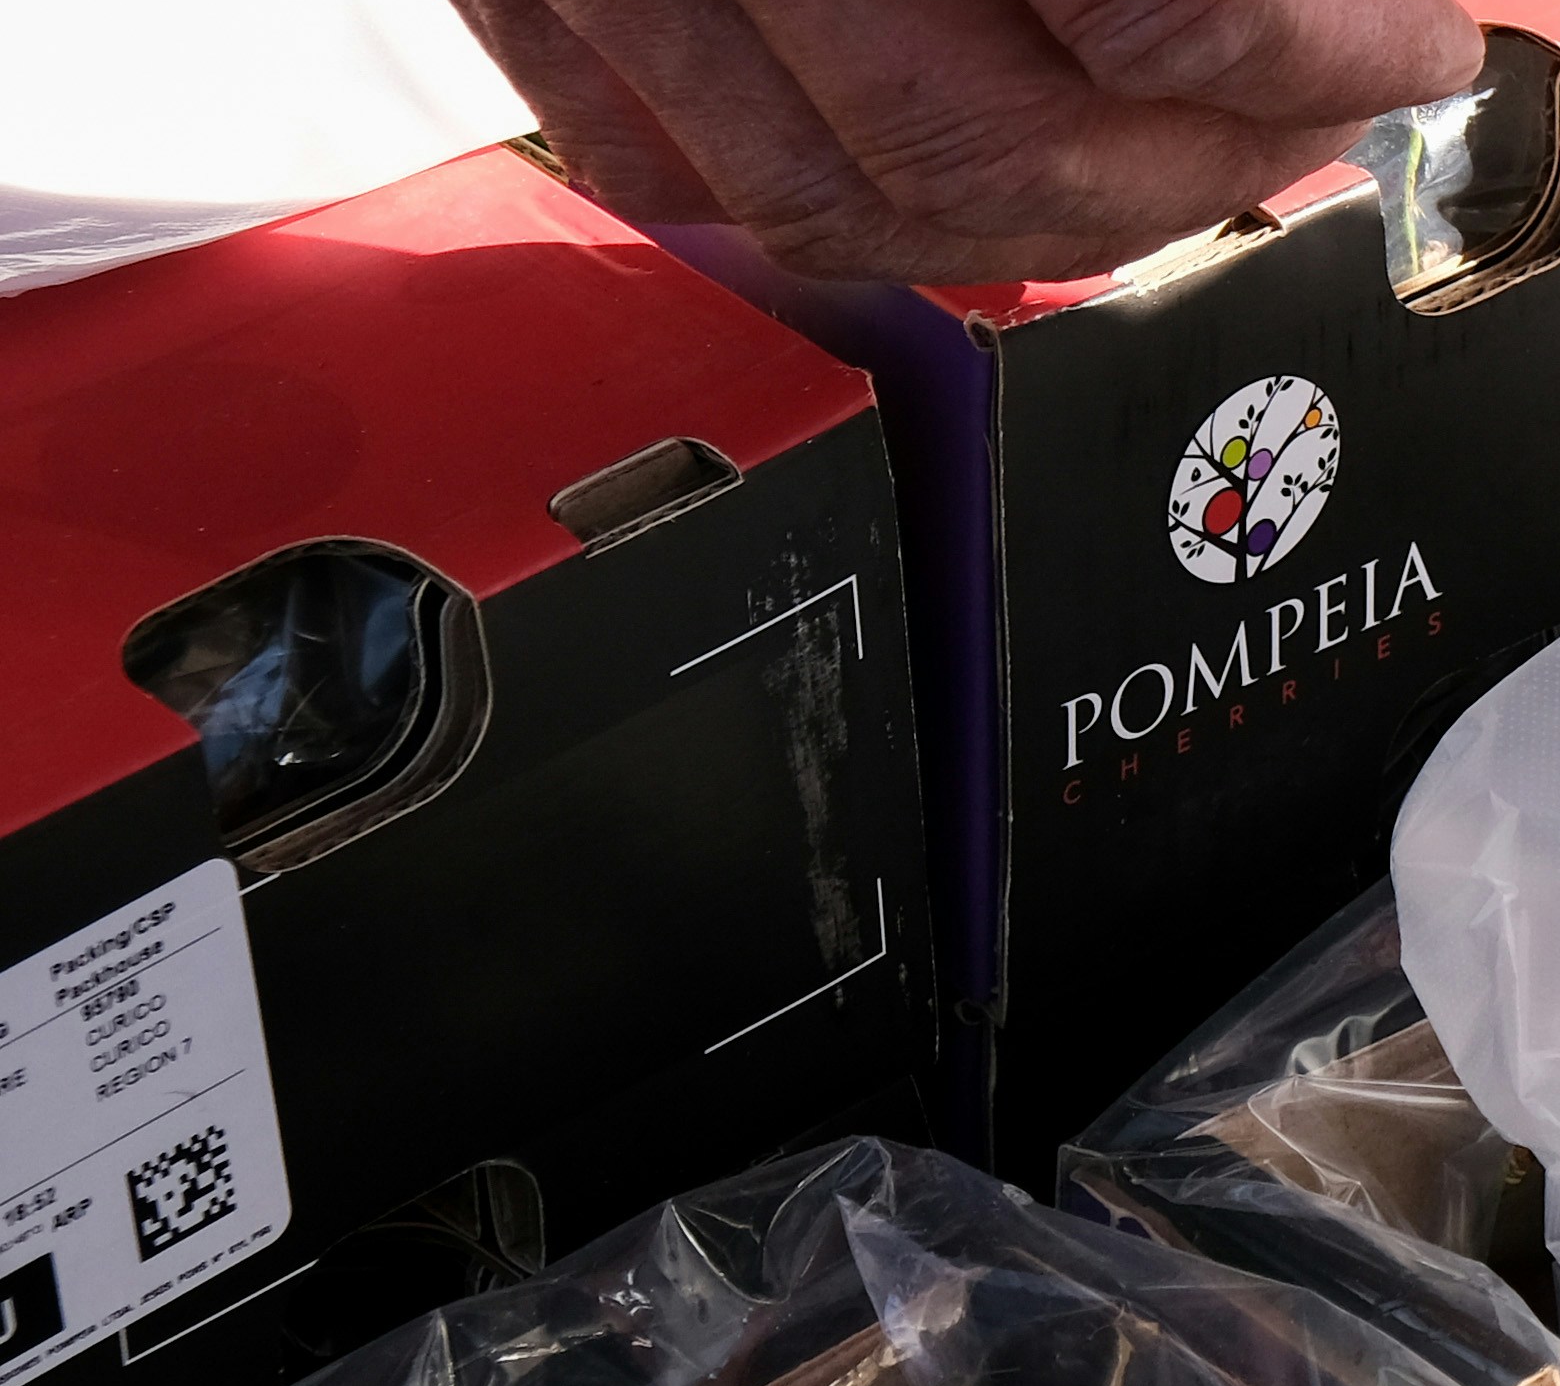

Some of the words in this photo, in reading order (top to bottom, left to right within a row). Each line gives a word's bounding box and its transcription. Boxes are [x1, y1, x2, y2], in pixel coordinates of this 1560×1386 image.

[1061, 541, 1443, 771] POMPEIA
[1063, 612, 1443, 804] CHERRIES
[55, 940, 164, 1006] Packhouse
[86, 994, 167, 1047] CURICO
[90, 1020, 171, 1073] CURICO
[95, 1047, 177, 1102] REGION
[180, 1036, 193, 1055] 7
